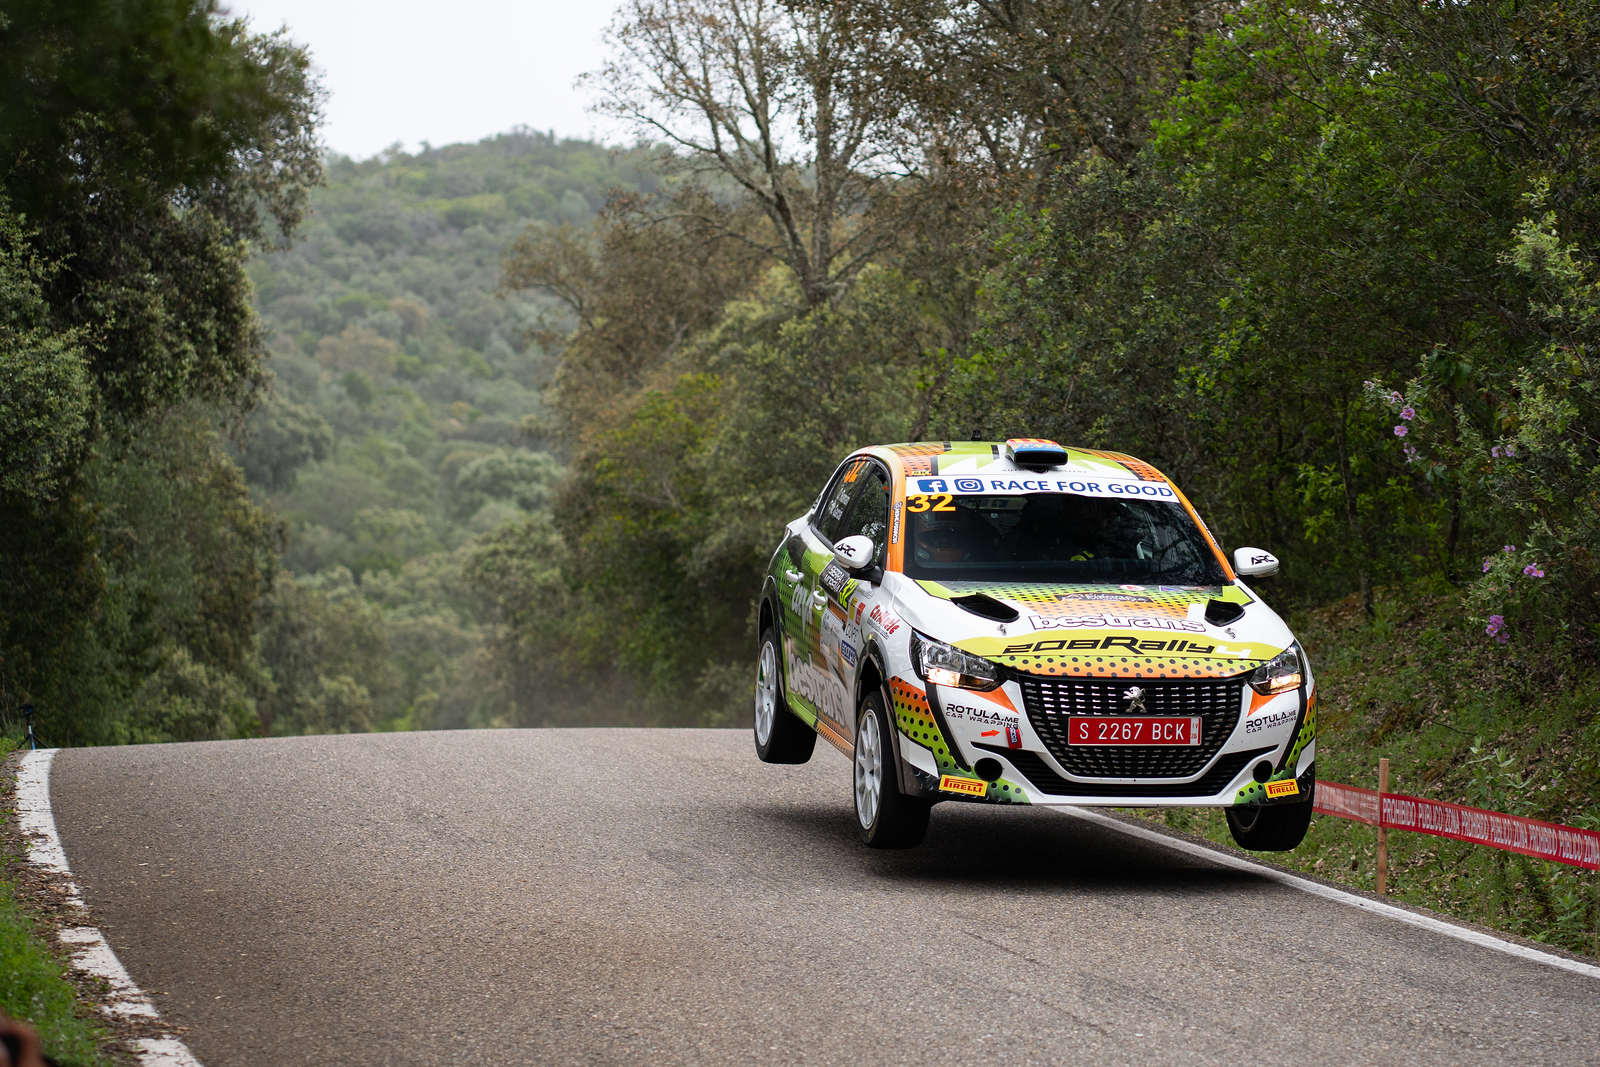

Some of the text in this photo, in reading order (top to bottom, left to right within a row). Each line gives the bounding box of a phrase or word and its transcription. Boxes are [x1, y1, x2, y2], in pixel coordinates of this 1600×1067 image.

[990, 480, 1173, 497] RACE FOR GOOD
[906, 492, 957, 513] 32
[835, 542, 856, 558] ARC
[1028, 612, 1207, 633] bestrans
[945, 711, 1019, 729] CAR WRAPPING
[946, 703, 1020, 724] ROTULA.ME
[1079, 722, 1185, 741] S 2267 BCK
[1246, 726, 1262, 734] CAR
[943, 777, 984, 793] PIRELLI
[1267, 781, 1296, 795] PIRELLI
[1382, 797, 1417, 828] PROHIBIDO
